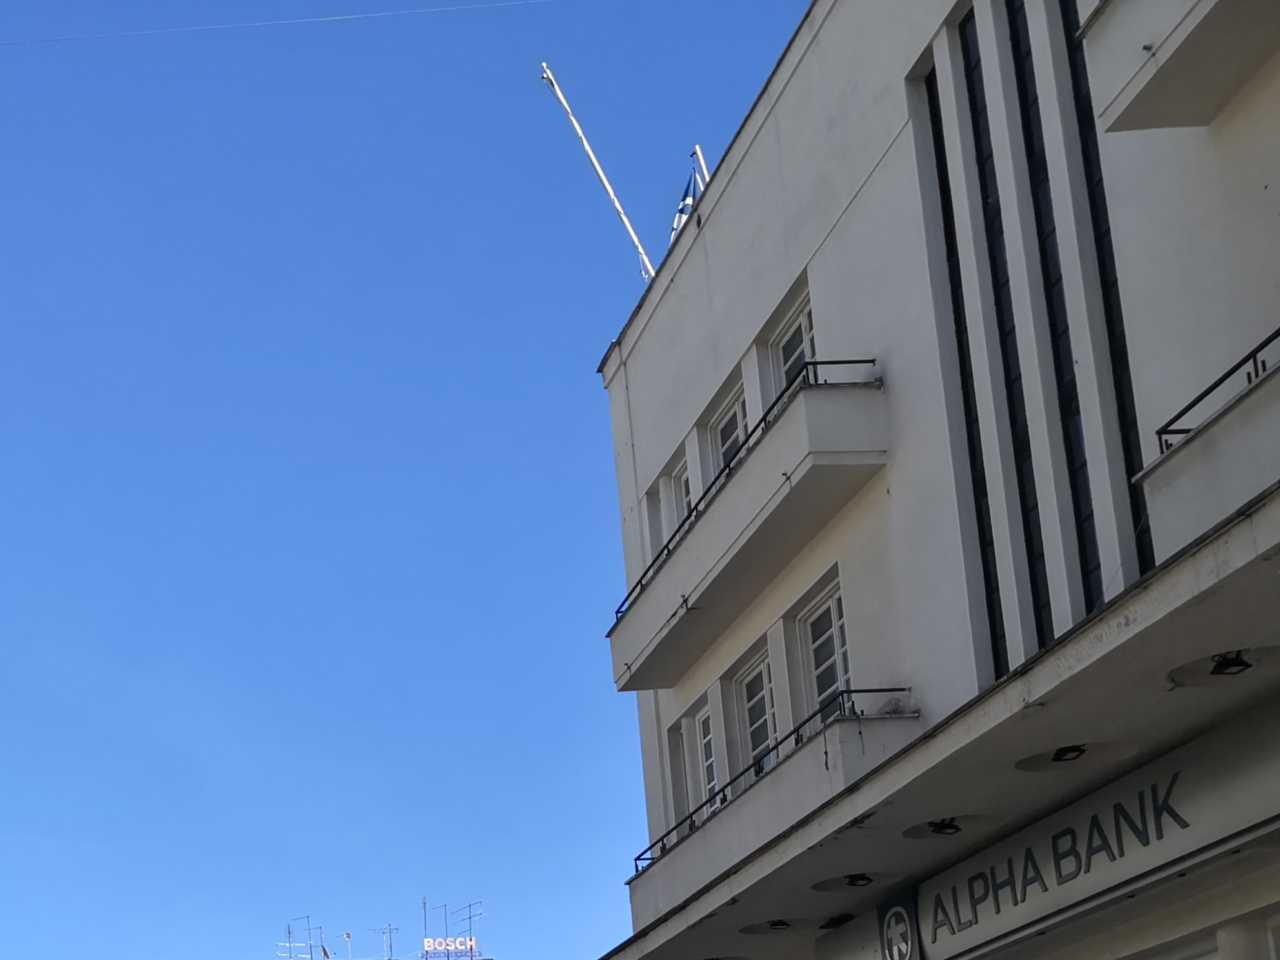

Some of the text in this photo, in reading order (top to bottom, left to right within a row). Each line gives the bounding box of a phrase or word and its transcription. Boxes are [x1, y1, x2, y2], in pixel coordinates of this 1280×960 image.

[931, 770, 1190, 944] ALPHA BANK
[423, 936, 476, 951] BOSCH
